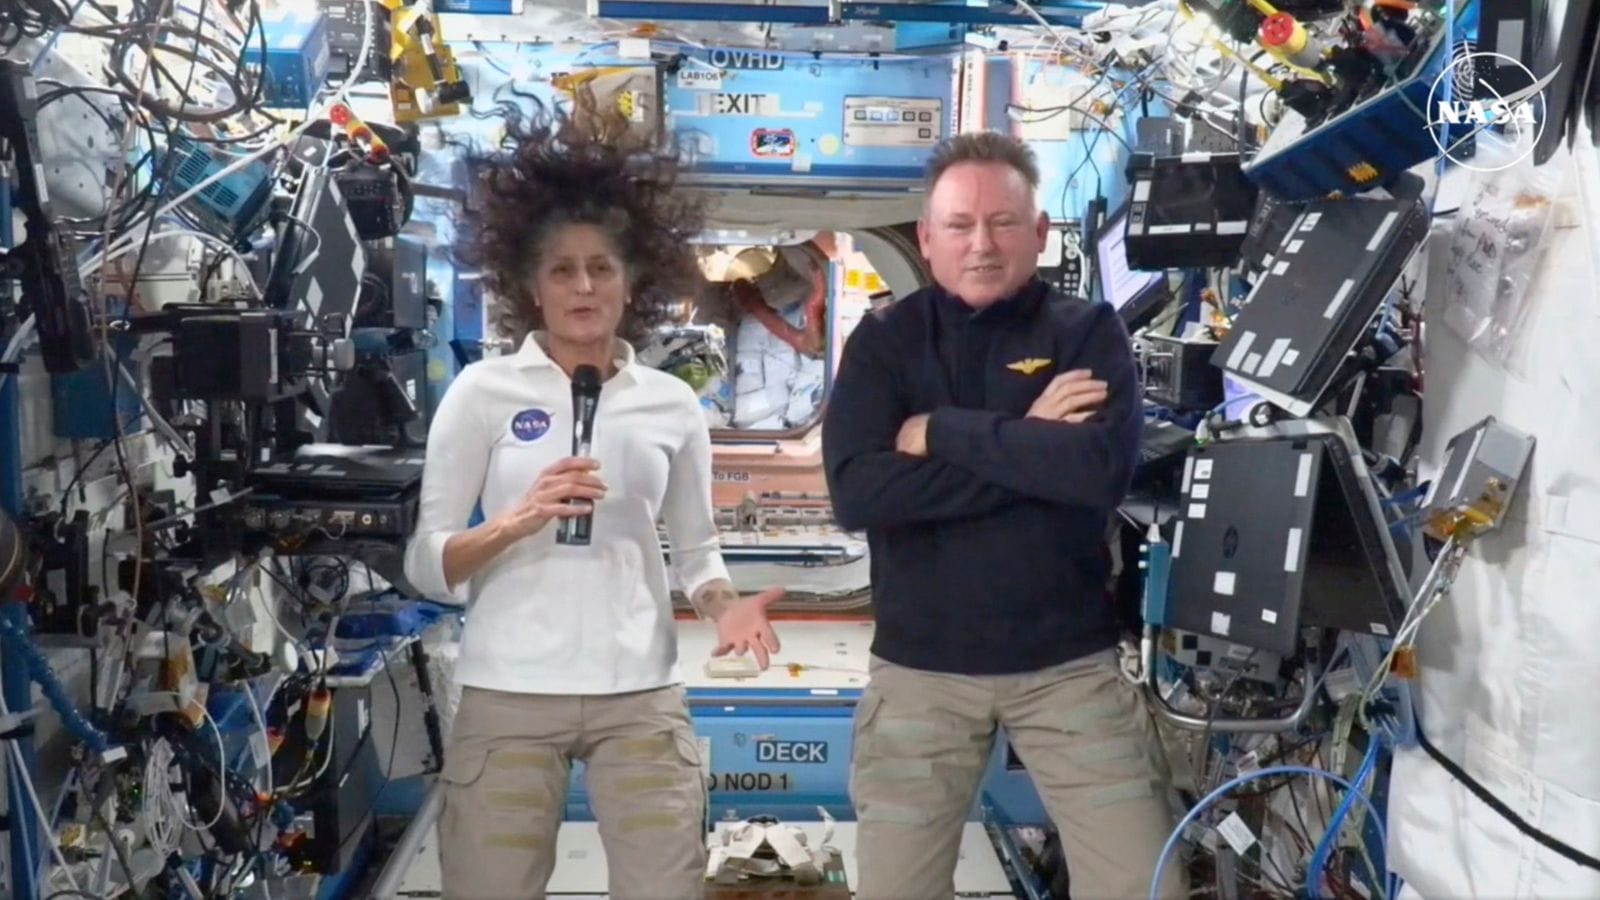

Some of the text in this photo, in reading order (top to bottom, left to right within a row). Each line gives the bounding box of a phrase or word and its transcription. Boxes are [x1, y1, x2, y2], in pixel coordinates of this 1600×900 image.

[711, 49, 782, 69] OVHD
[515, 421, 547, 429] NASA
[713, 471, 749, 481] To FGB
[759, 742, 825, 761] DECK
[725, 773, 772, 790] NOD
[779, 773, 788, 789] 1
